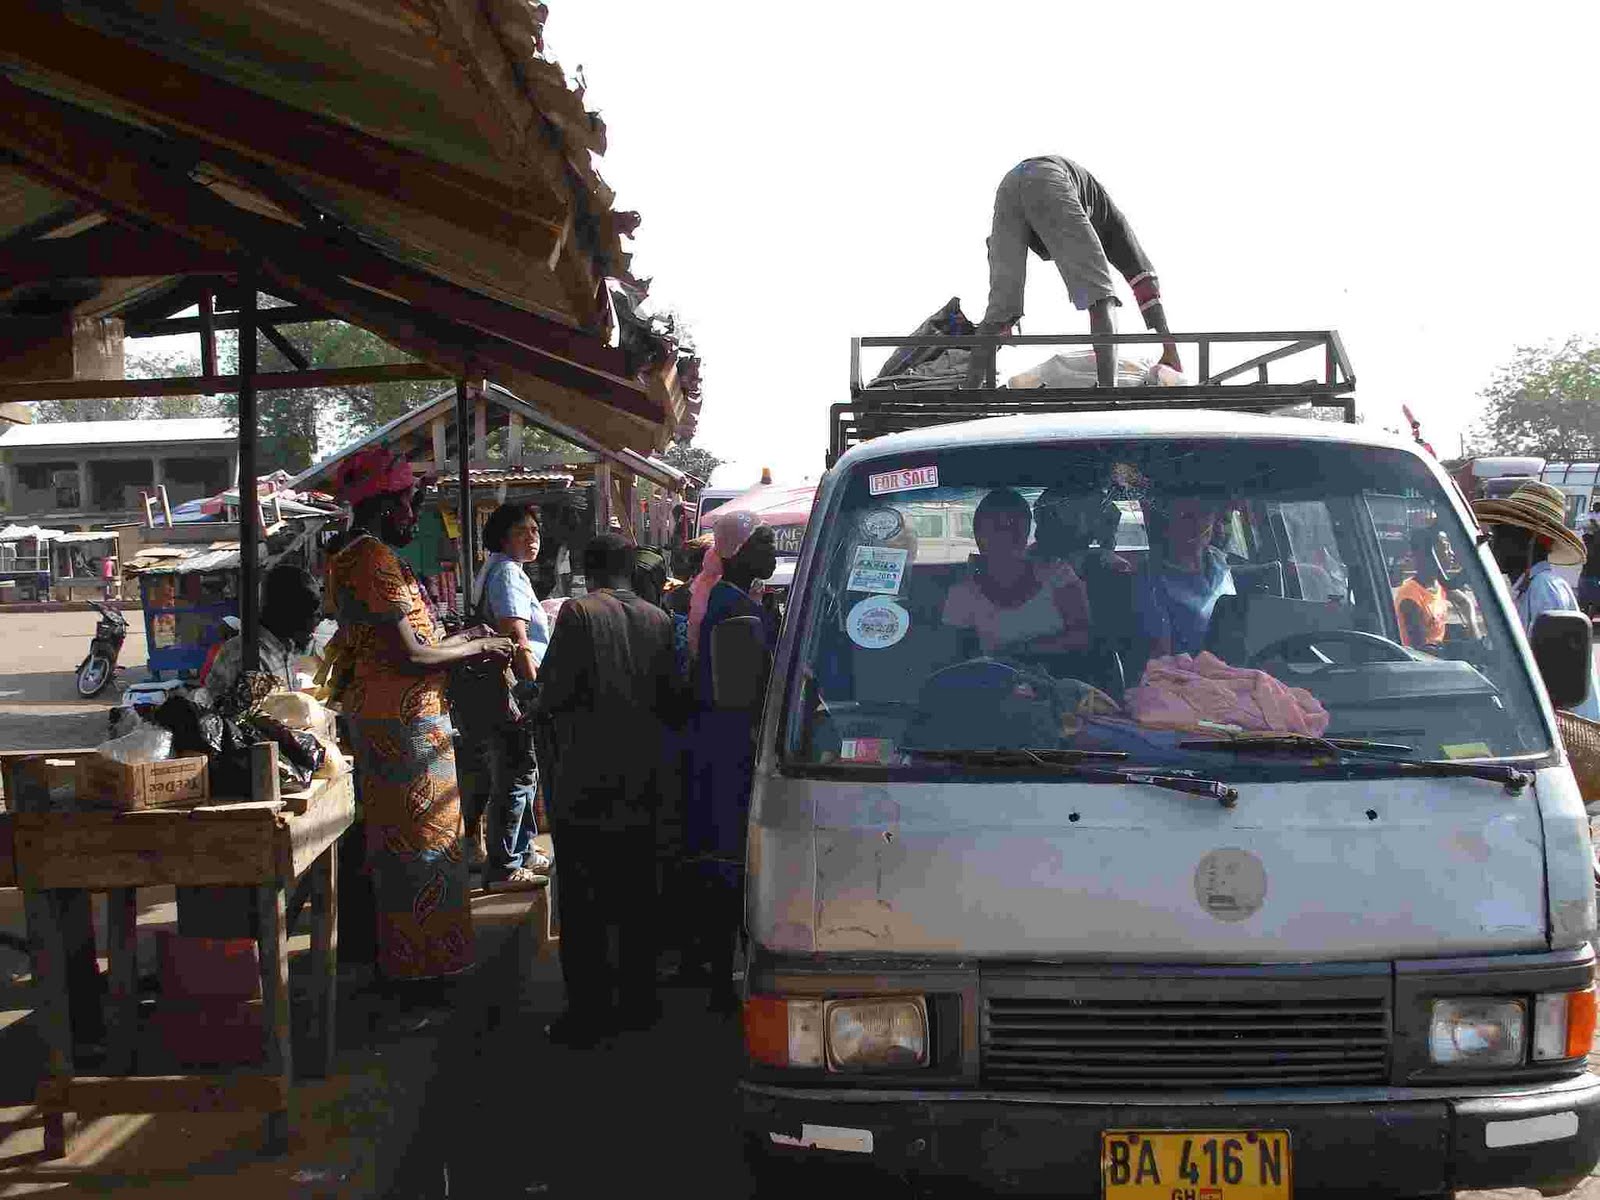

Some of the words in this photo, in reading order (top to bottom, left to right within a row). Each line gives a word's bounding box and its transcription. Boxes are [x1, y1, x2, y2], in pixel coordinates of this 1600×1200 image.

[874, 475, 899, 490] FOR
[904, 469, 935, 486] SALE
[1110, 1139, 1161, 1186] BA
[1179, 1138, 1243, 1186] 416
[1259, 1138, 1282, 1186] N
